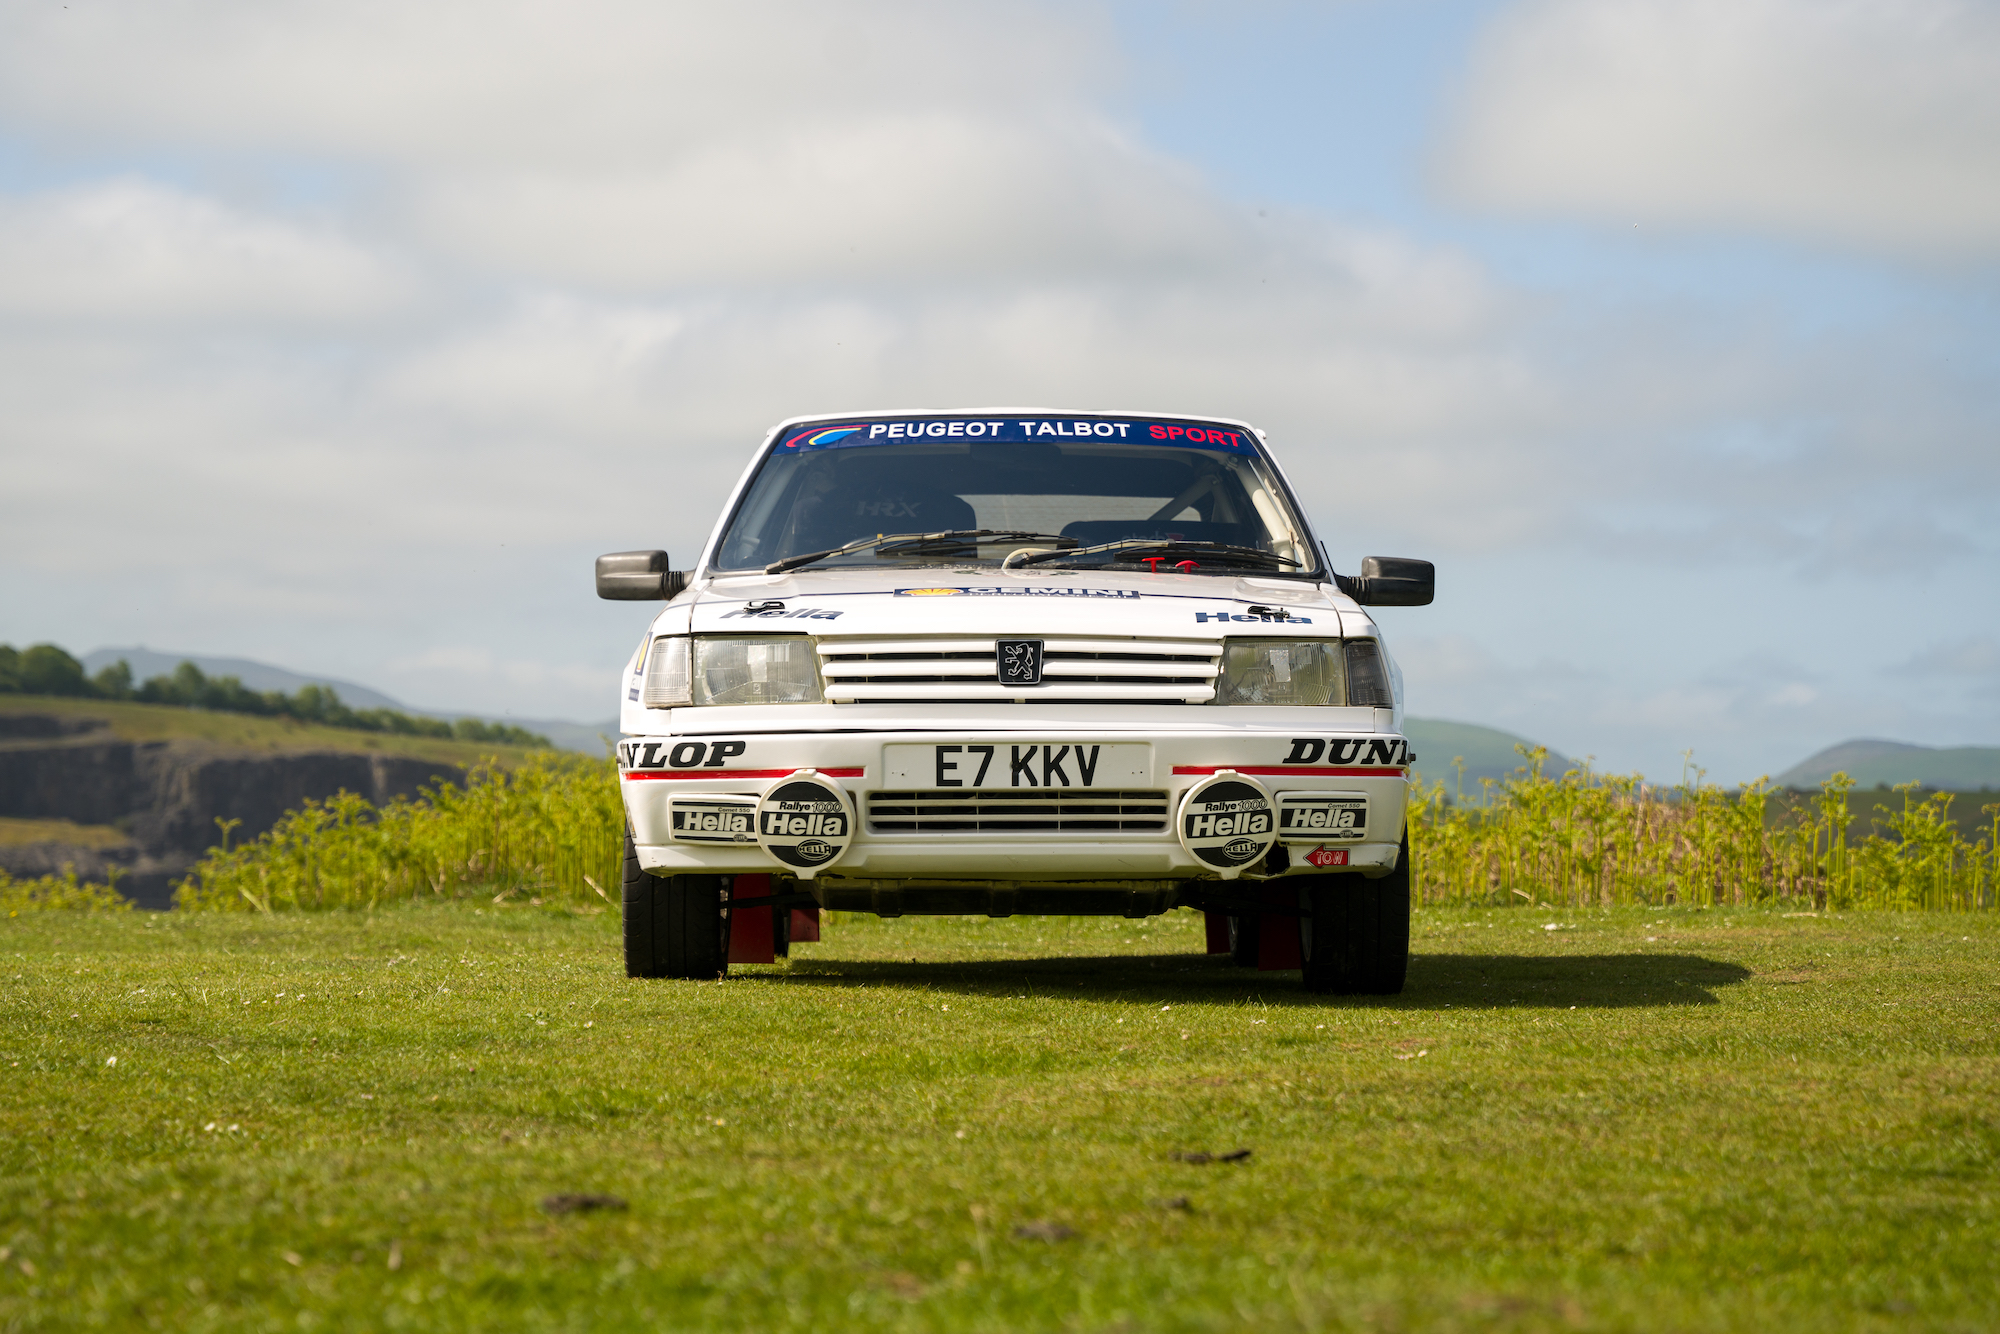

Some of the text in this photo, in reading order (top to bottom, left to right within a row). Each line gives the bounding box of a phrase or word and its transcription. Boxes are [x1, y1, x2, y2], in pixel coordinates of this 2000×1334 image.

[869, 421, 1241, 448] PEUGEOT TALBOT SPORT
[936, 745, 1100, 787] E7 KKV
[779, 802, 842, 812] Rallye 1000
[1205, 800, 1268, 812] Rallye 1000
[683, 812, 747, 832] Hella
[766, 813, 843, 836] Hella
[1192, 813, 1268, 837] Hella
[1290, 809, 1356, 828] Hella
[798, 845, 831, 854] HELLA
[1226, 843, 1258, 853] HELLA
[1316, 851, 1344, 865] TOW
